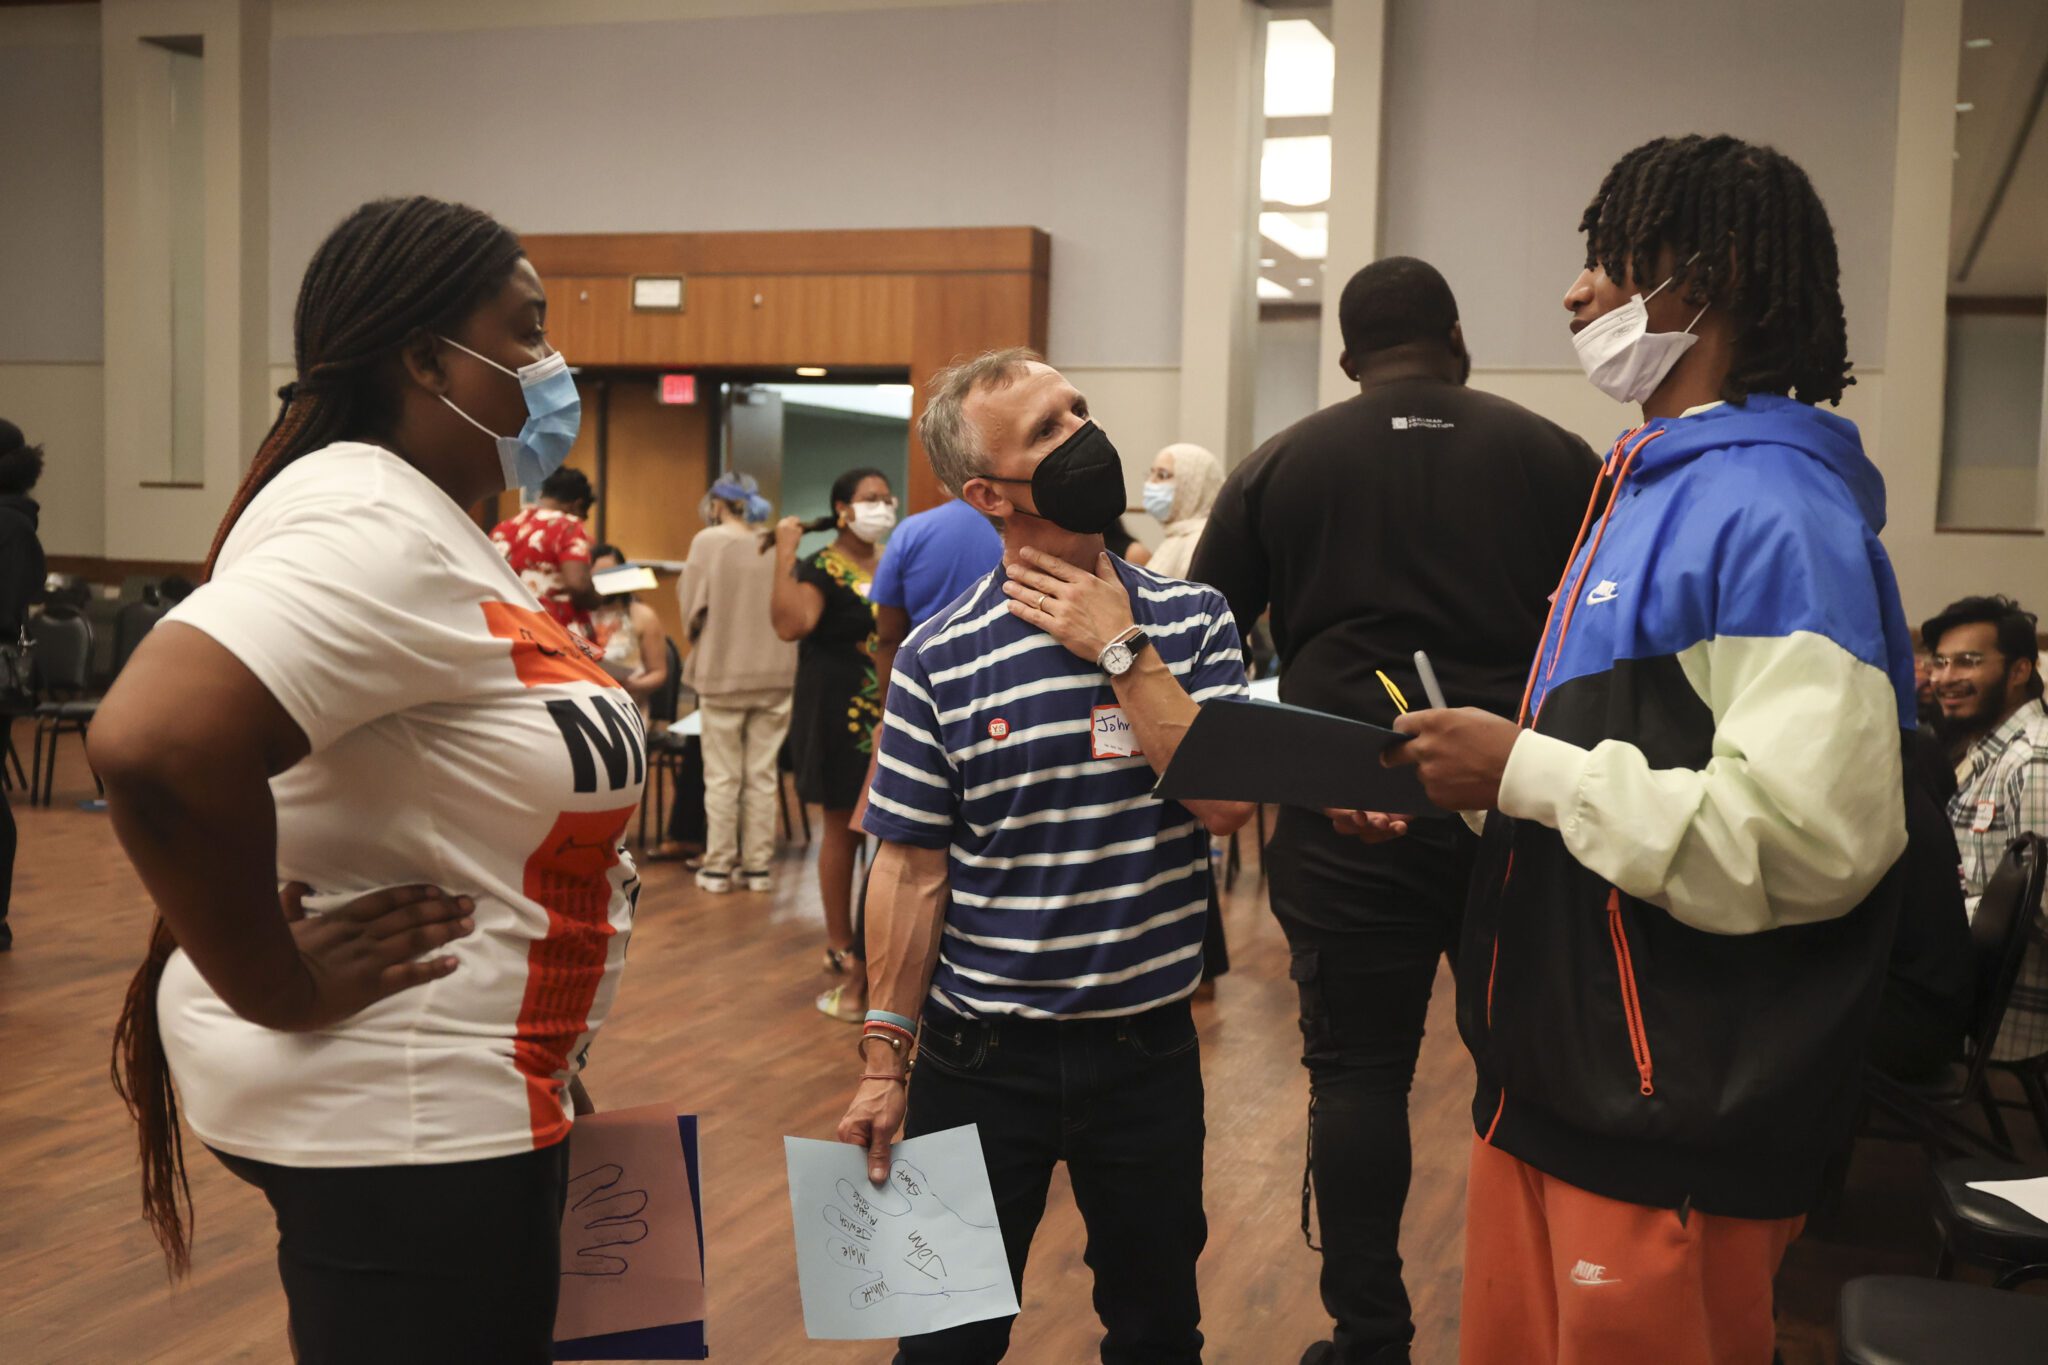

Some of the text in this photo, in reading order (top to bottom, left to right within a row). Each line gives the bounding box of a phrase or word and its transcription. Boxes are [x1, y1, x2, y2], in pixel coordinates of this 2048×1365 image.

[895, 1169, 922, 1196] Short
[852, 1202, 878, 1226] Middle
[839, 1214, 873, 1241] Jewish
[841, 1246, 866, 1266] Male
[903, 1229, 948, 1281] John
[1574, 1259, 1607, 1281] NIKE
[861, 1280, 890, 1304] White
